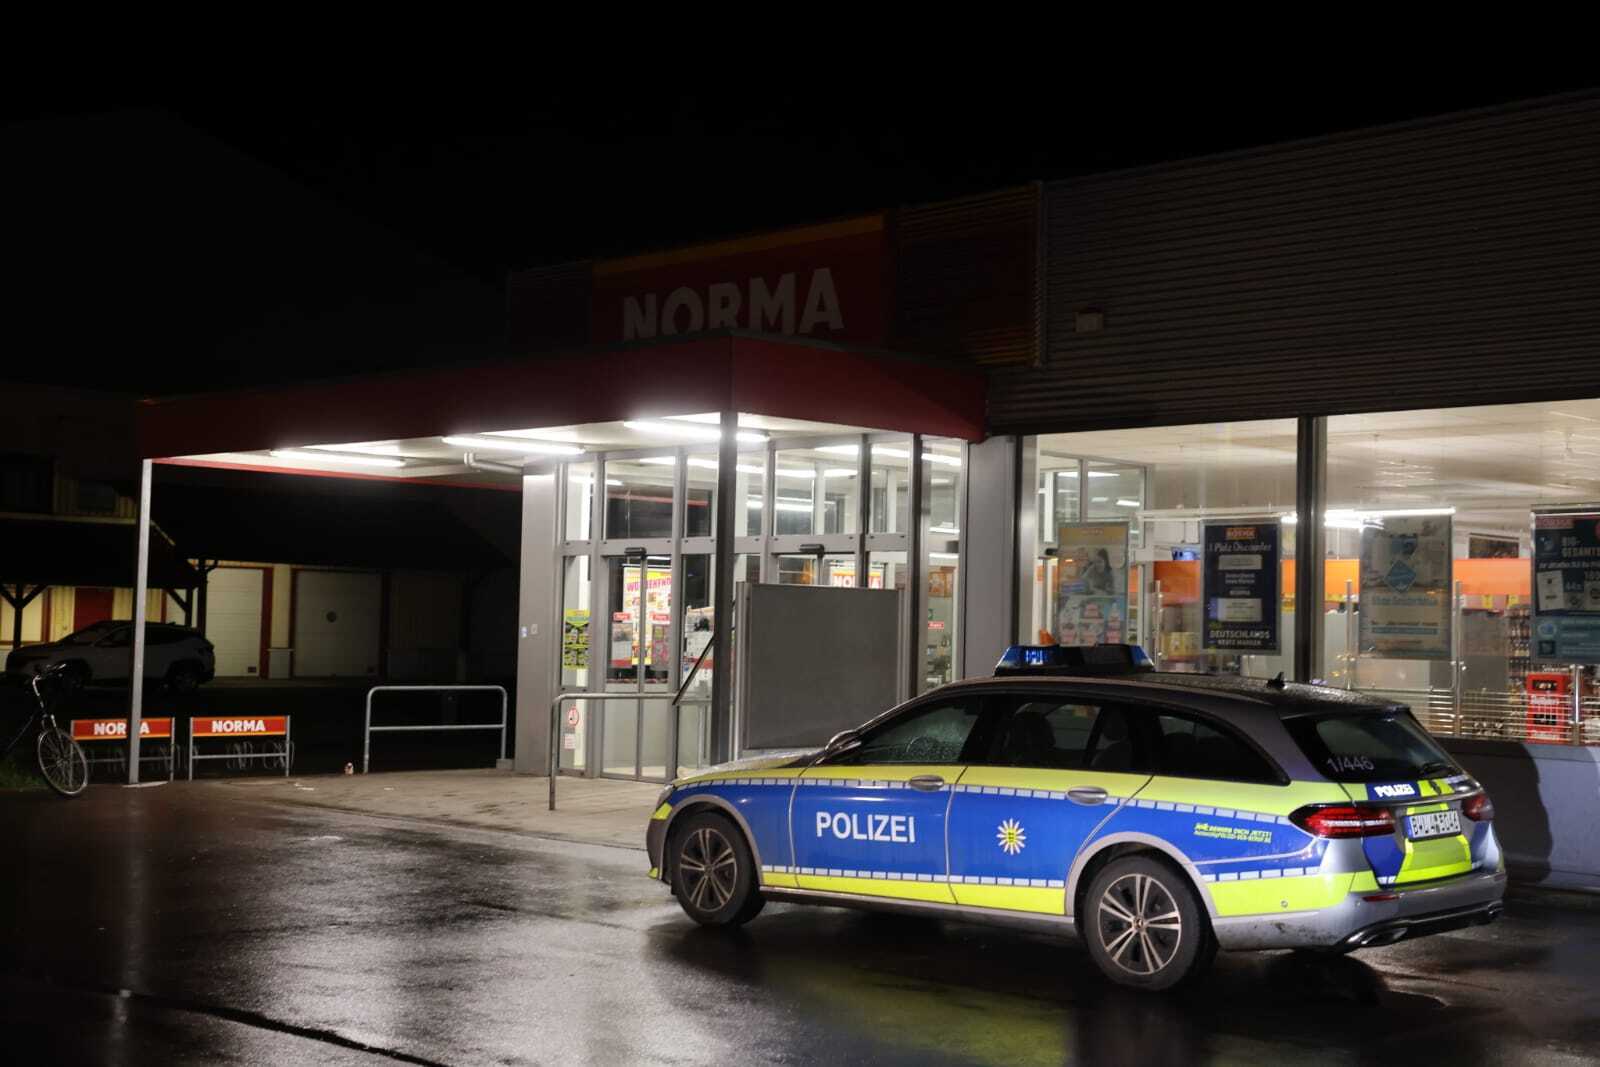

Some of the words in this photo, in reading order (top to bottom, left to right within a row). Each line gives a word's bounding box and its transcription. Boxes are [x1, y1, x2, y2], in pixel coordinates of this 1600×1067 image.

[623, 266, 845, 341] NORMA
[94, 721, 149, 735] NORA
[211, 719, 265, 733] NORMA
[1374, 784, 1415, 797] POLIZEI
[816, 811, 916, 843] POLIZEI
